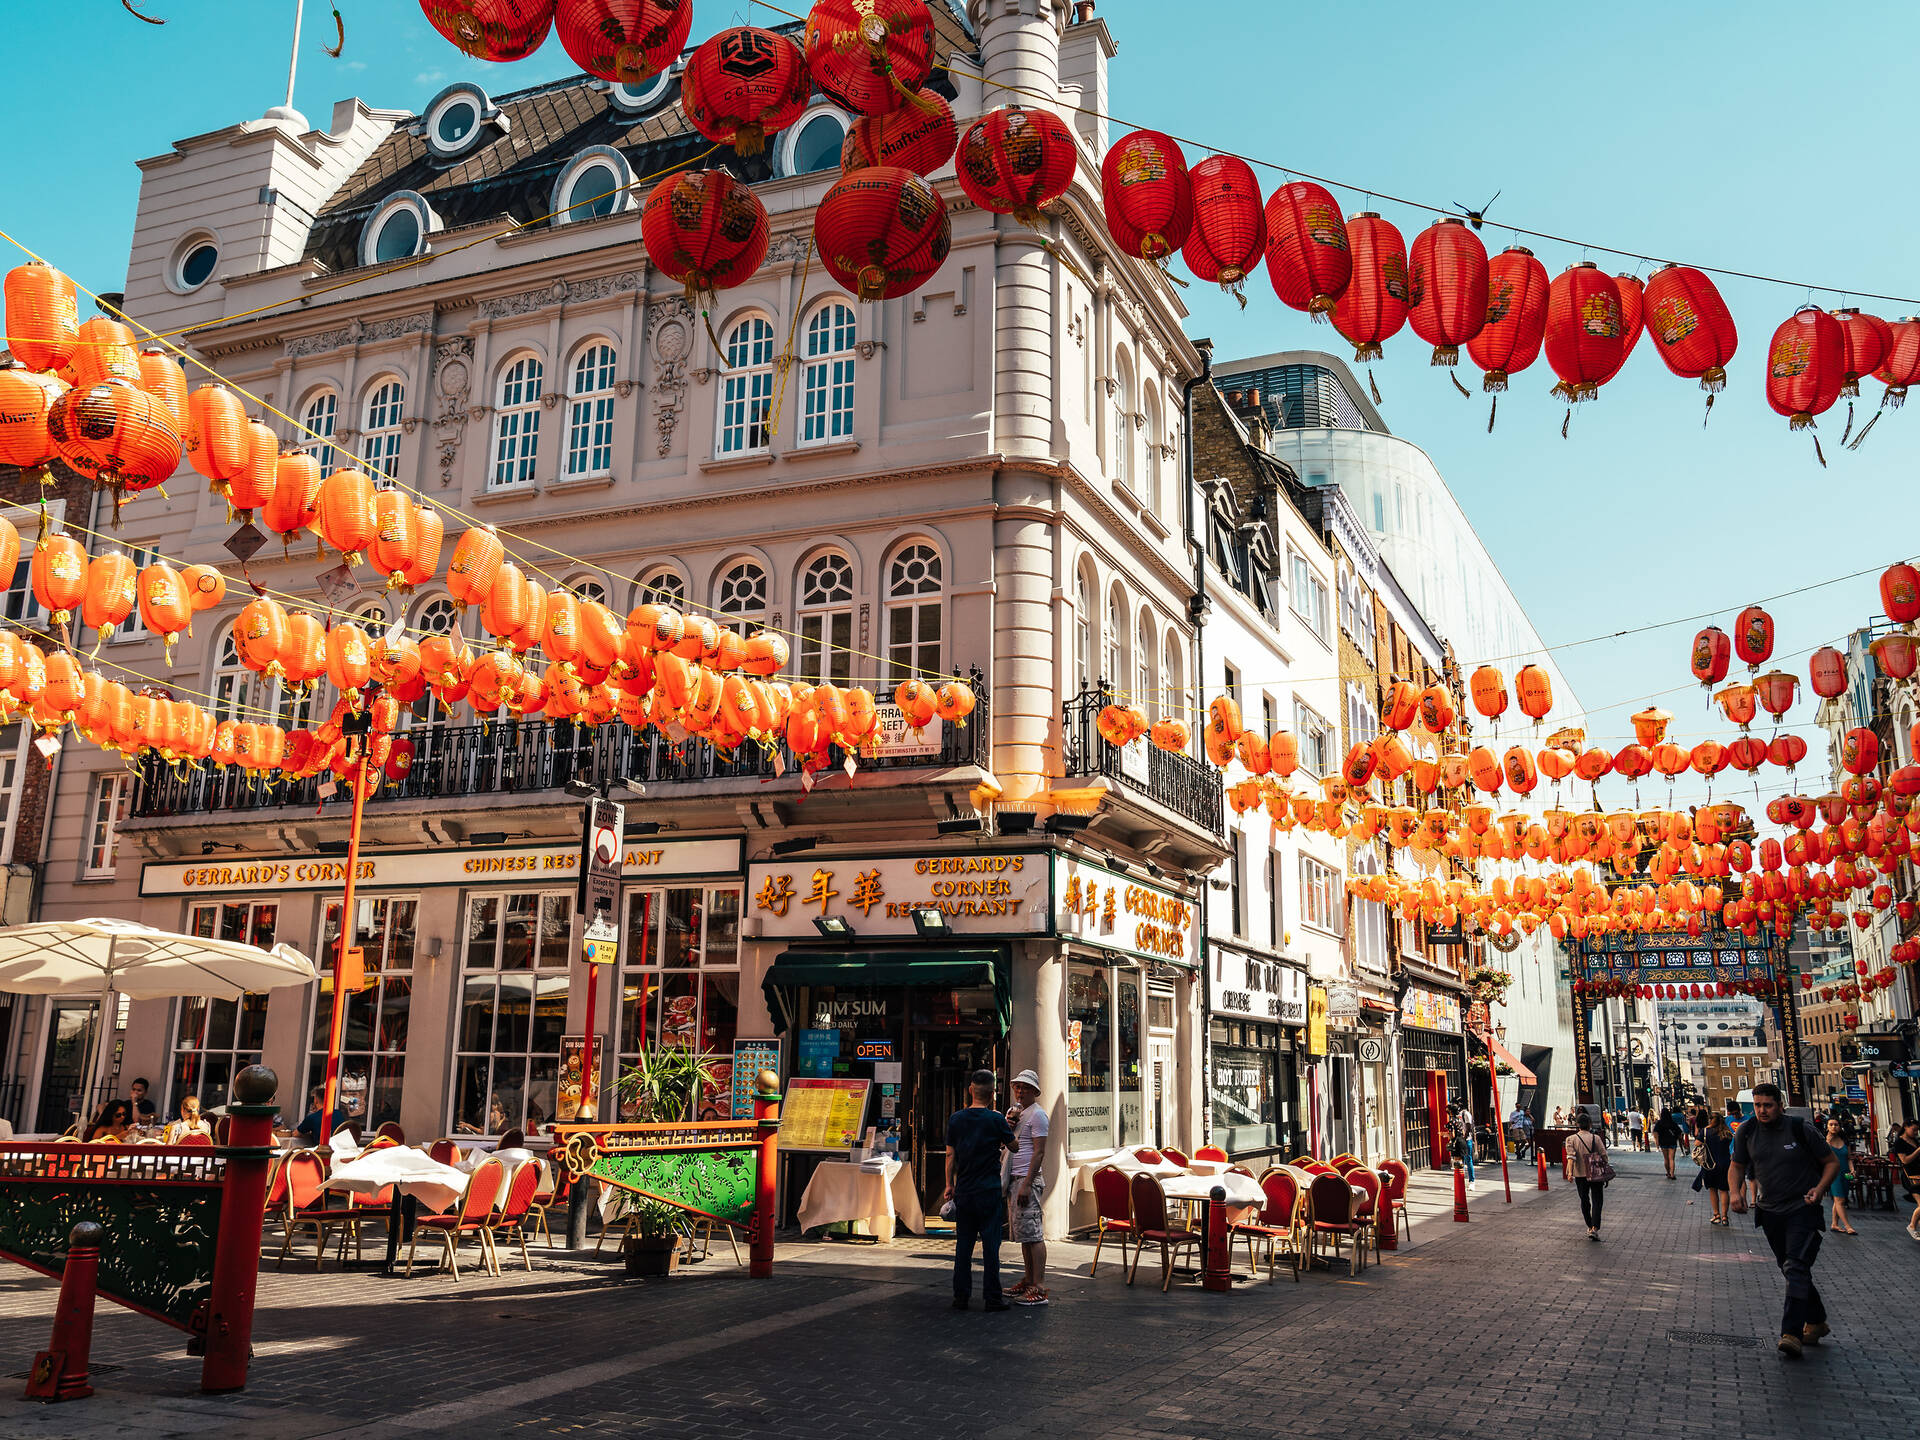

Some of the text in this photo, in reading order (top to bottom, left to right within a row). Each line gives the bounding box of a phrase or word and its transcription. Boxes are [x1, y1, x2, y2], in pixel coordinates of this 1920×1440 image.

[746, 85, 777, 94] LAND
[597, 810, 618, 826] ZONE
[463, 850, 664, 873] CHINESE RESTANT
[914, 855, 1024, 875] GERRARD'S
[183, 864, 289, 886] GERRARD'S
[593, 878, 608, 887] Except
[592, 886, 608, 896] loading
[755, 867, 885, 917] 好年華
[931, 879, 1011, 897] CORNER
[1125, 884, 1191, 932] GERRARD'S
[1135, 921, 1185, 960] CORNER
[817, 1000, 887, 1016] DIM SUM
[838, 1020, 858, 1029] DAILY
[857, 1045, 892, 1057] OPEN
[1217, 1069, 1233, 1086] HOT
[1068, 1106, 1085, 1117] CHINESE
[1085, 1106, 1110, 1116] RESTAURANT
